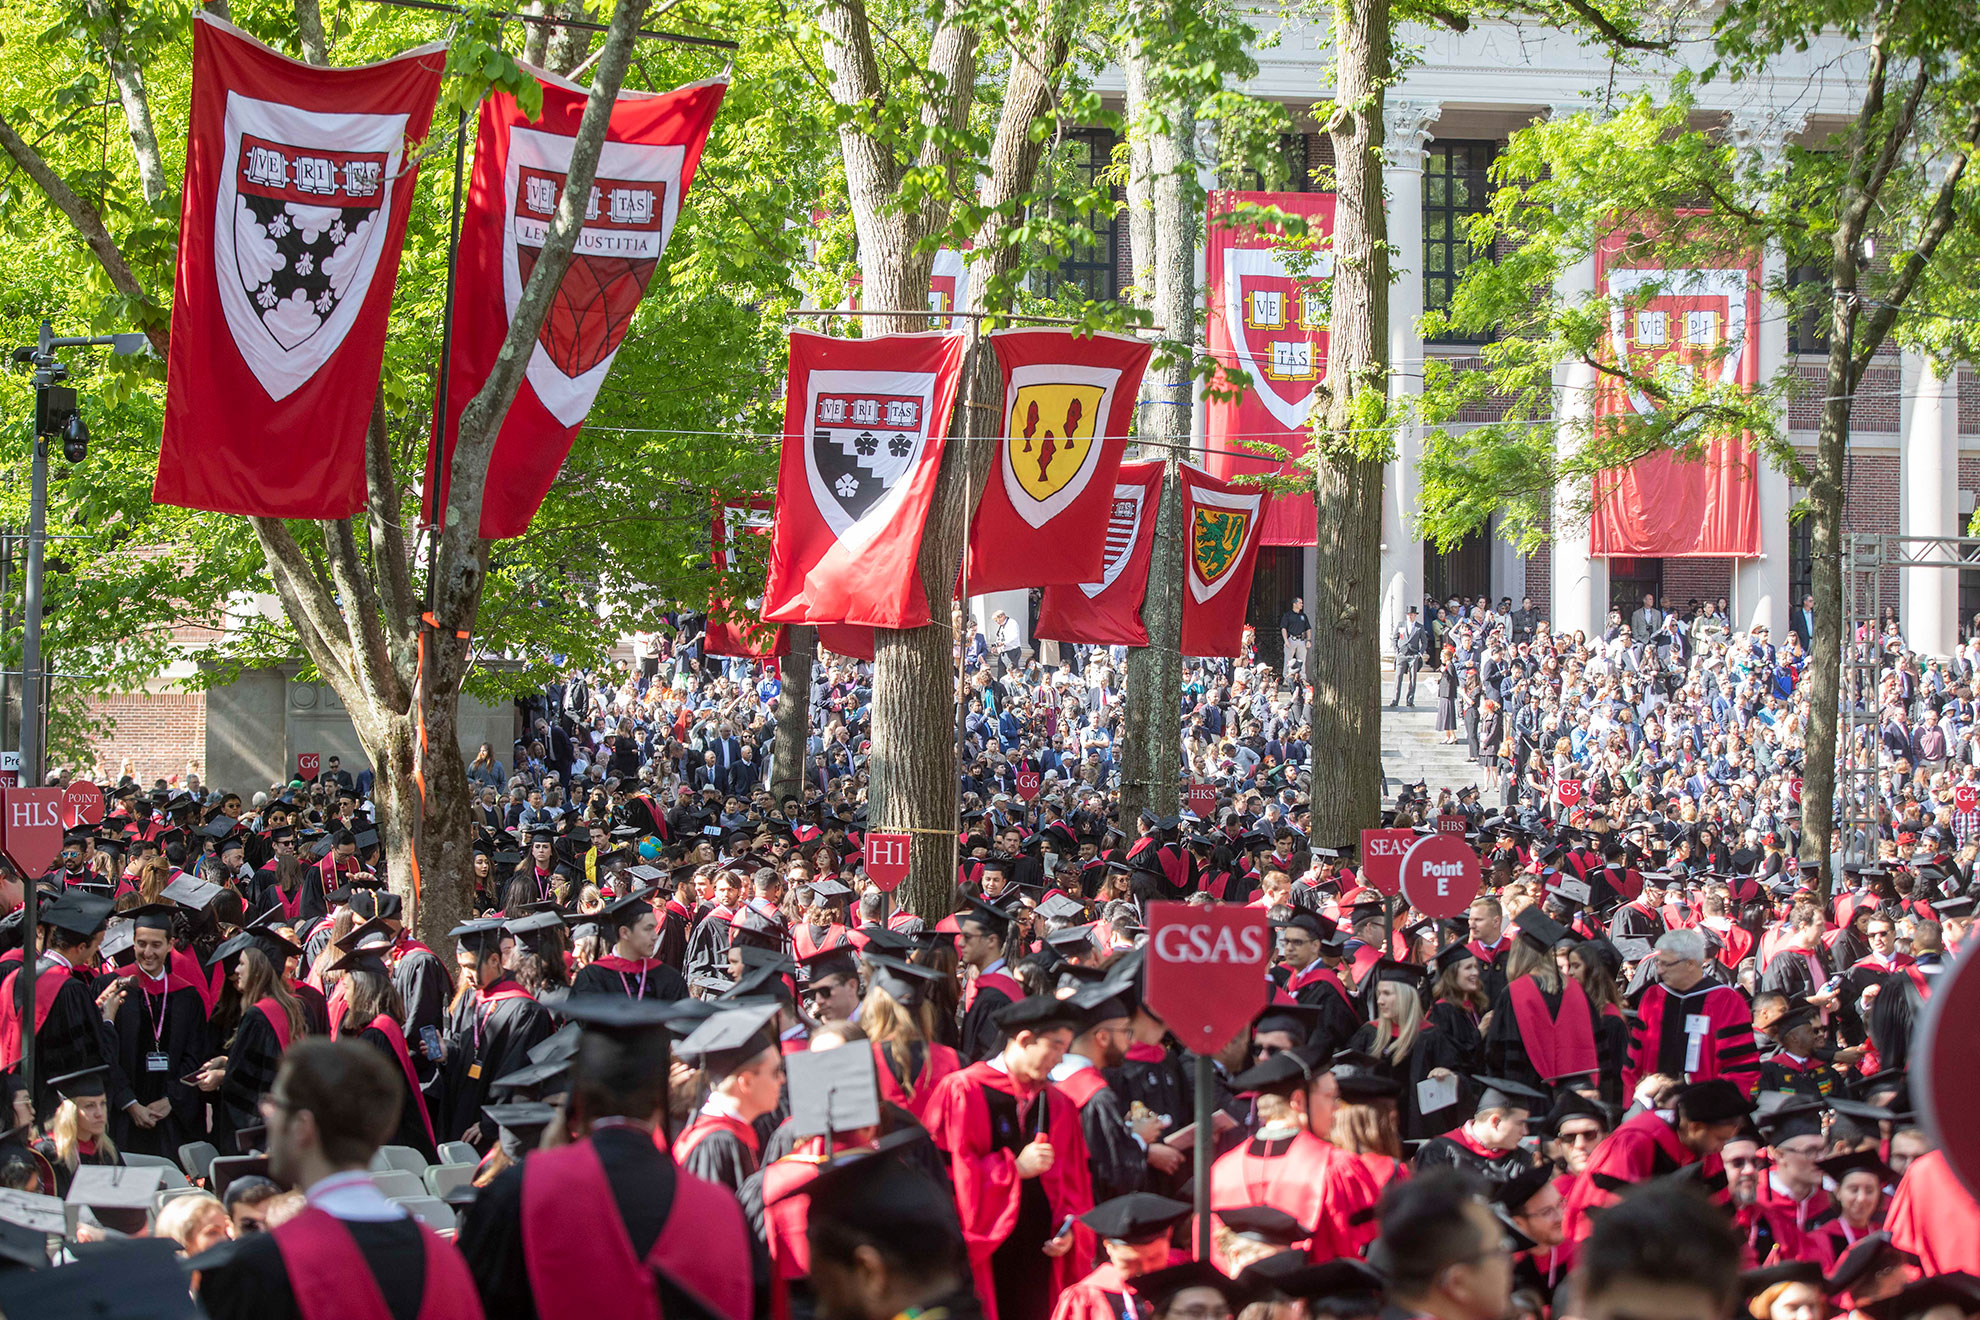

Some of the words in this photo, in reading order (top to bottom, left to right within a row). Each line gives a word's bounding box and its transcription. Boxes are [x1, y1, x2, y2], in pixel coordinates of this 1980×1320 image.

[258, 154, 279, 173] VE
[304, 163, 324, 180] RI
[532, 185, 548, 202] VE
[618, 197, 645, 212] TAS
[1256, 300, 1277, 317] VE
[1639, 320, 1662, 336] VE
[1277, 349, 1308, 365] TAS
[825, 403, 841, 415] VE
[858, 404, 872, 416] RI
[892, 406, 912, 417] TAS
[299, 755, 319, 769] G6
[1019, 774, 1038, 789] G6
[1560, 782, 1579, 796] G5
[68, 793, 99, 803] POINT
[1190, 789, 1215, 800] HKS
[1957, 788, 1975, 802] G4
[12, 801, 59, 827] HLS
[72, 804, 92, 826] K
[1440, 820, 1465, 832] HBS
[870, 840, 905, 866] H1
[1369, 838, 1412, 856] SEAS
[1422, 860, 1464, 877] Point
[1437, 878, 1449, 896] E
[1154, 923, 1264, 965] GSAS
